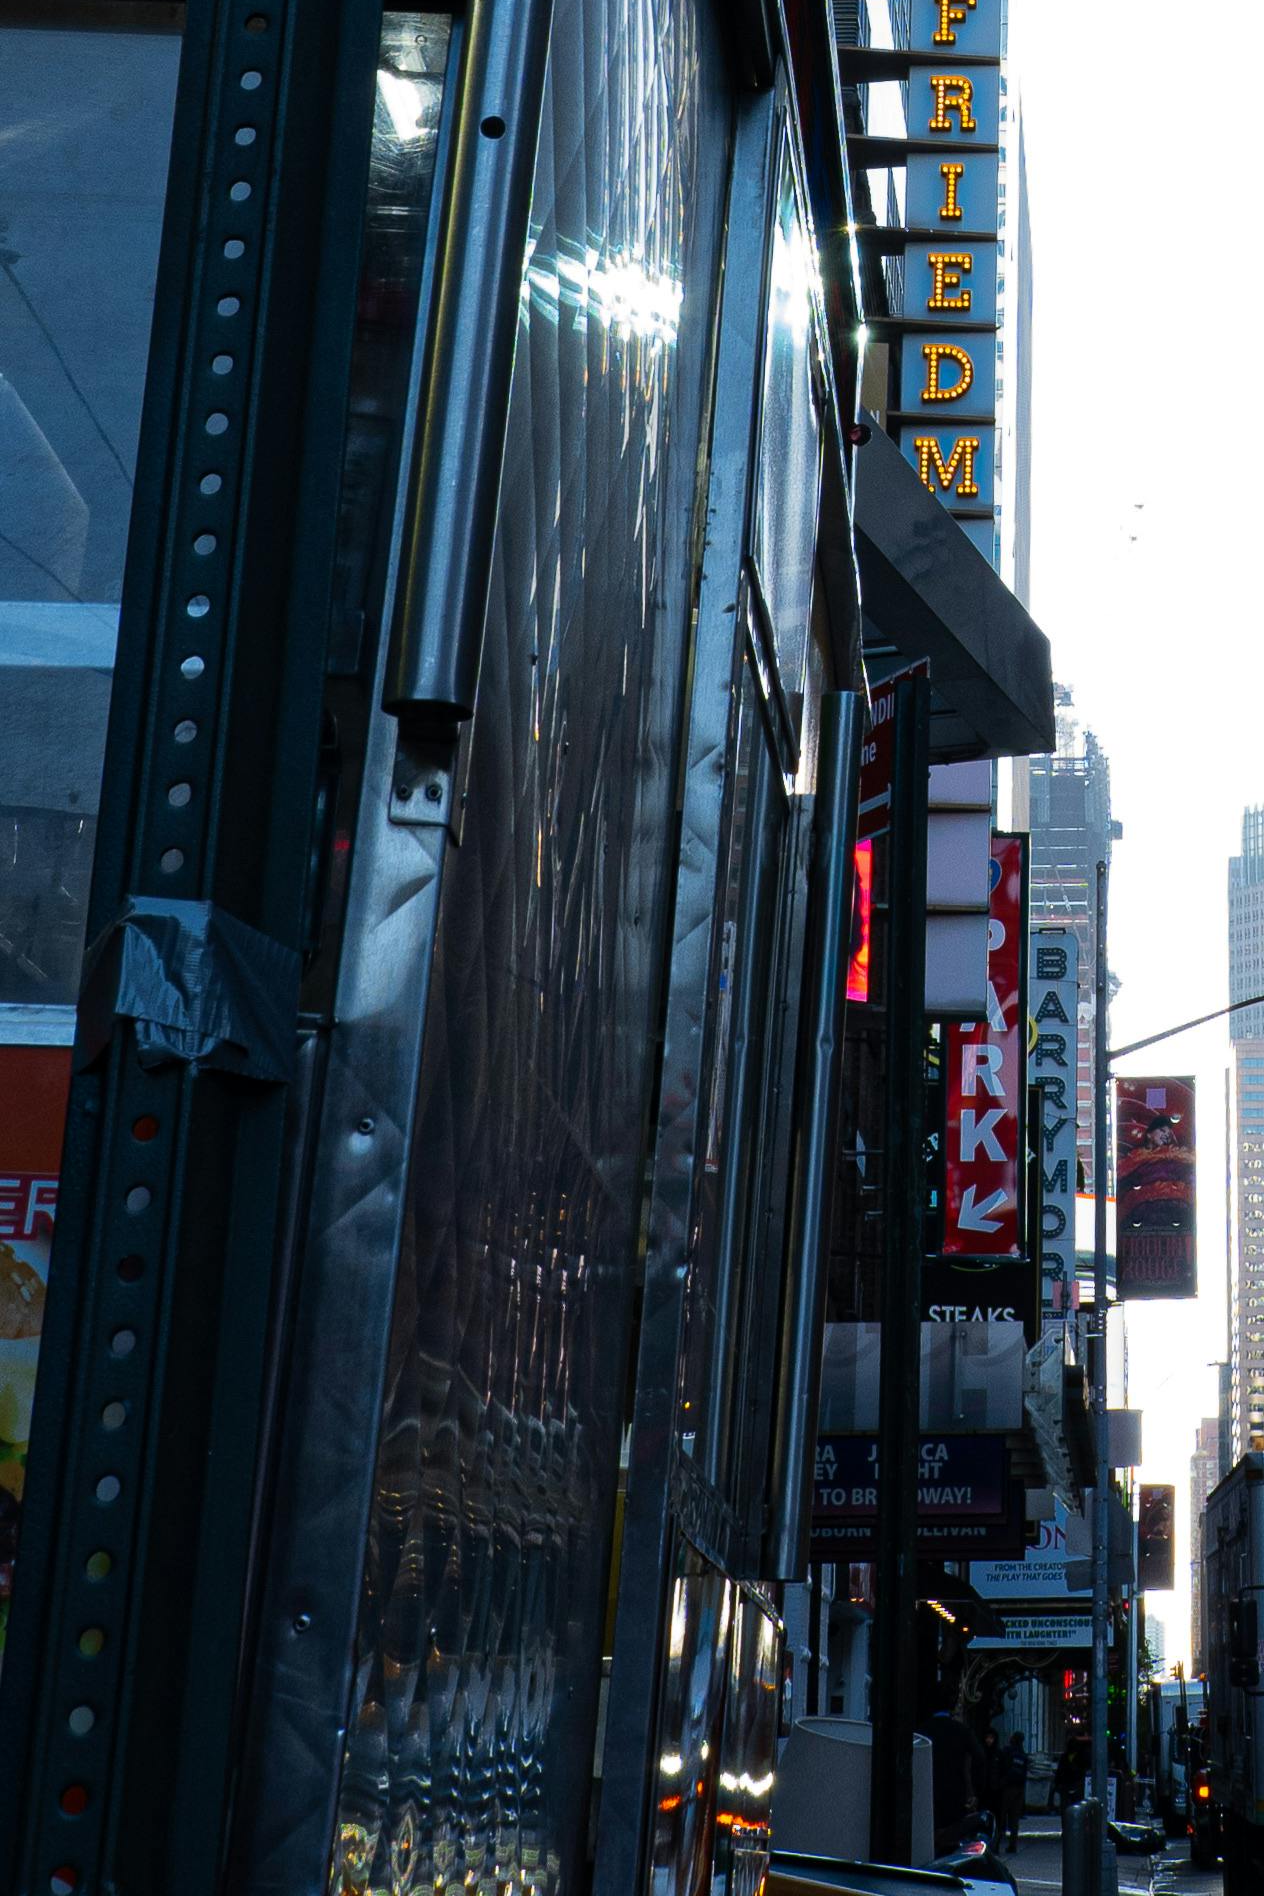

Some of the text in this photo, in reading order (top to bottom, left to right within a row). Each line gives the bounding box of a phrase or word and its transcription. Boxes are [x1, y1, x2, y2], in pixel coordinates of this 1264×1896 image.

[819, 1488, 846, 1506] TO
[994, 1563, 1016, 1572] FROM
[1018, 1563, 1032, 1572] THE
[986, 1572, 1062, 1582] THE PLAY THAT GOES
[1004, 1630, 1021, 1639] ITH
